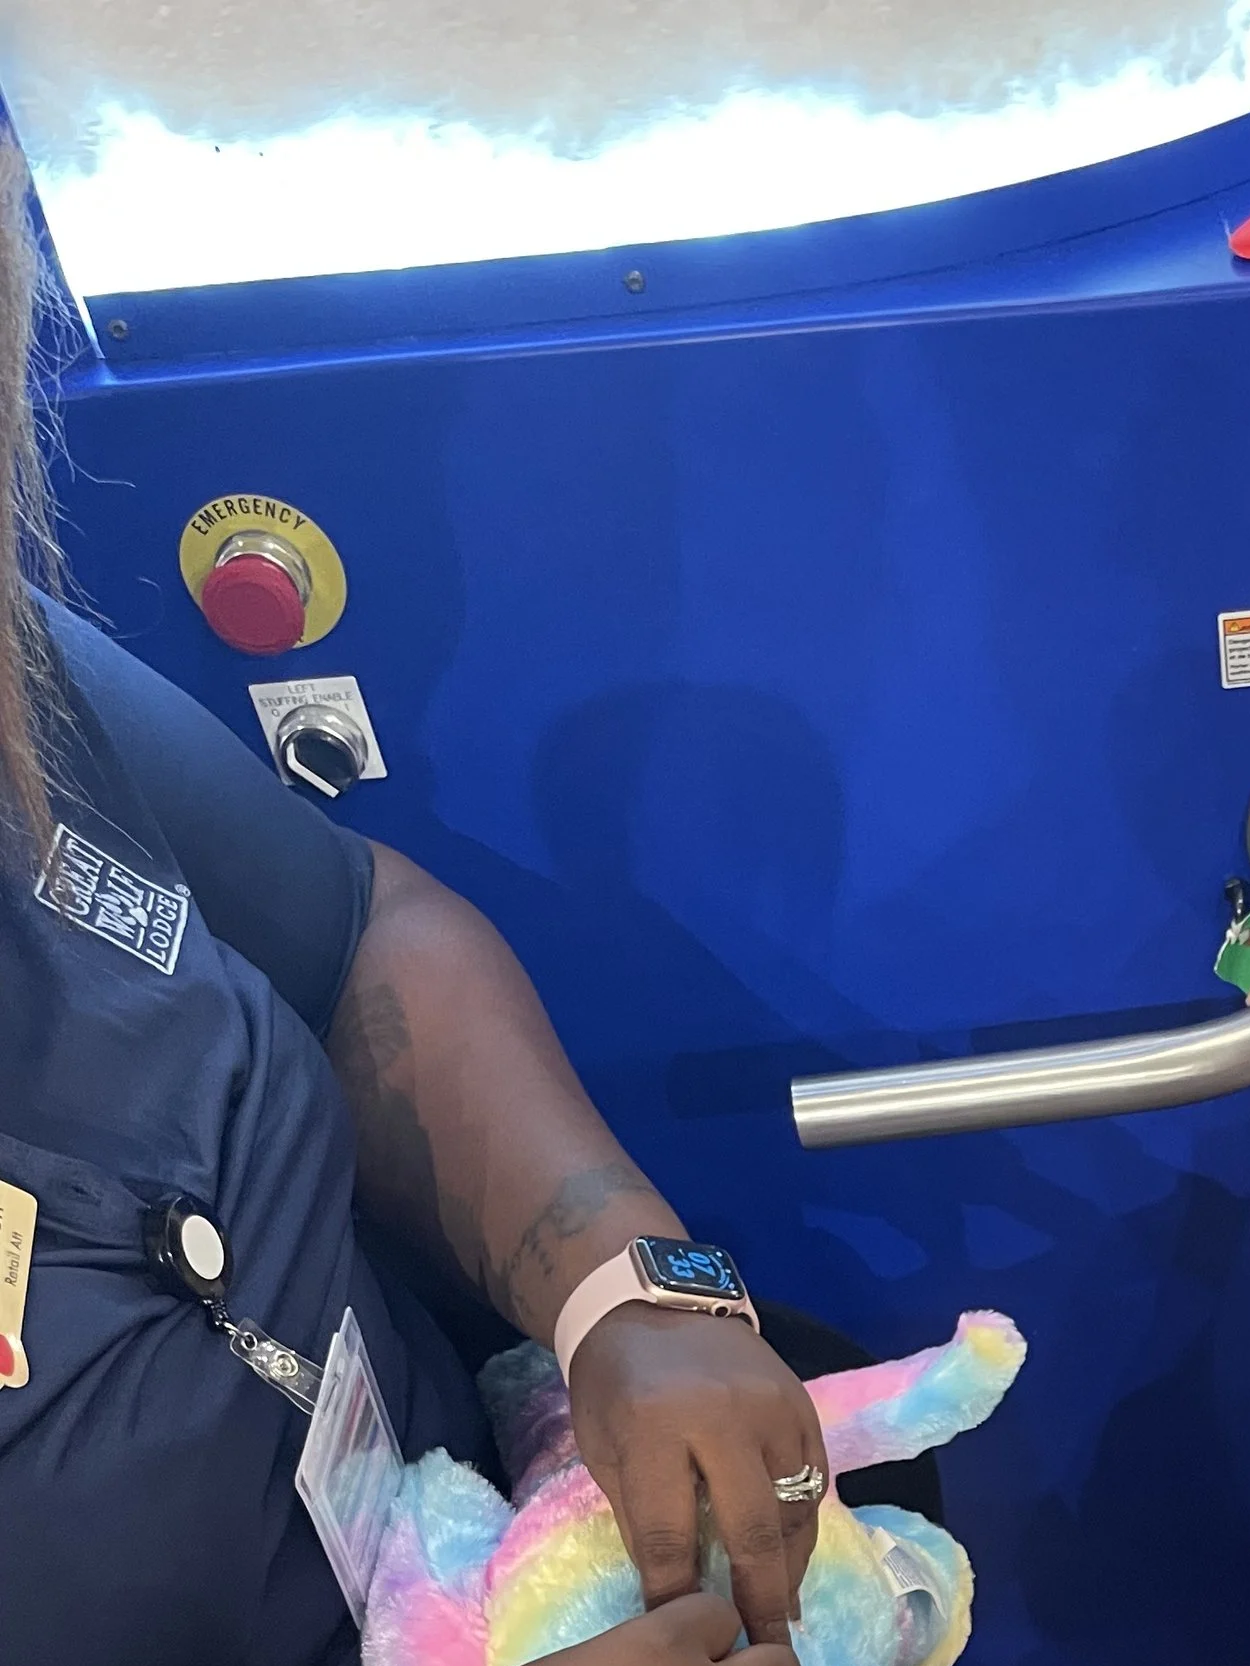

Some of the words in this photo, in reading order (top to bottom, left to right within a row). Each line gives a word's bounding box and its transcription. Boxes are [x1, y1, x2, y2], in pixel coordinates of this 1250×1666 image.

[191, 498, 306, 536] EMERGENCY
[258, 696, 309, 708] STUFFING
[312, 691, 353, 703] ENABLE
[287, 683, 316, 694] LEFT
[146, 895, 179, 964] LODGE
[5, 1251, 20, 1287] Retail
